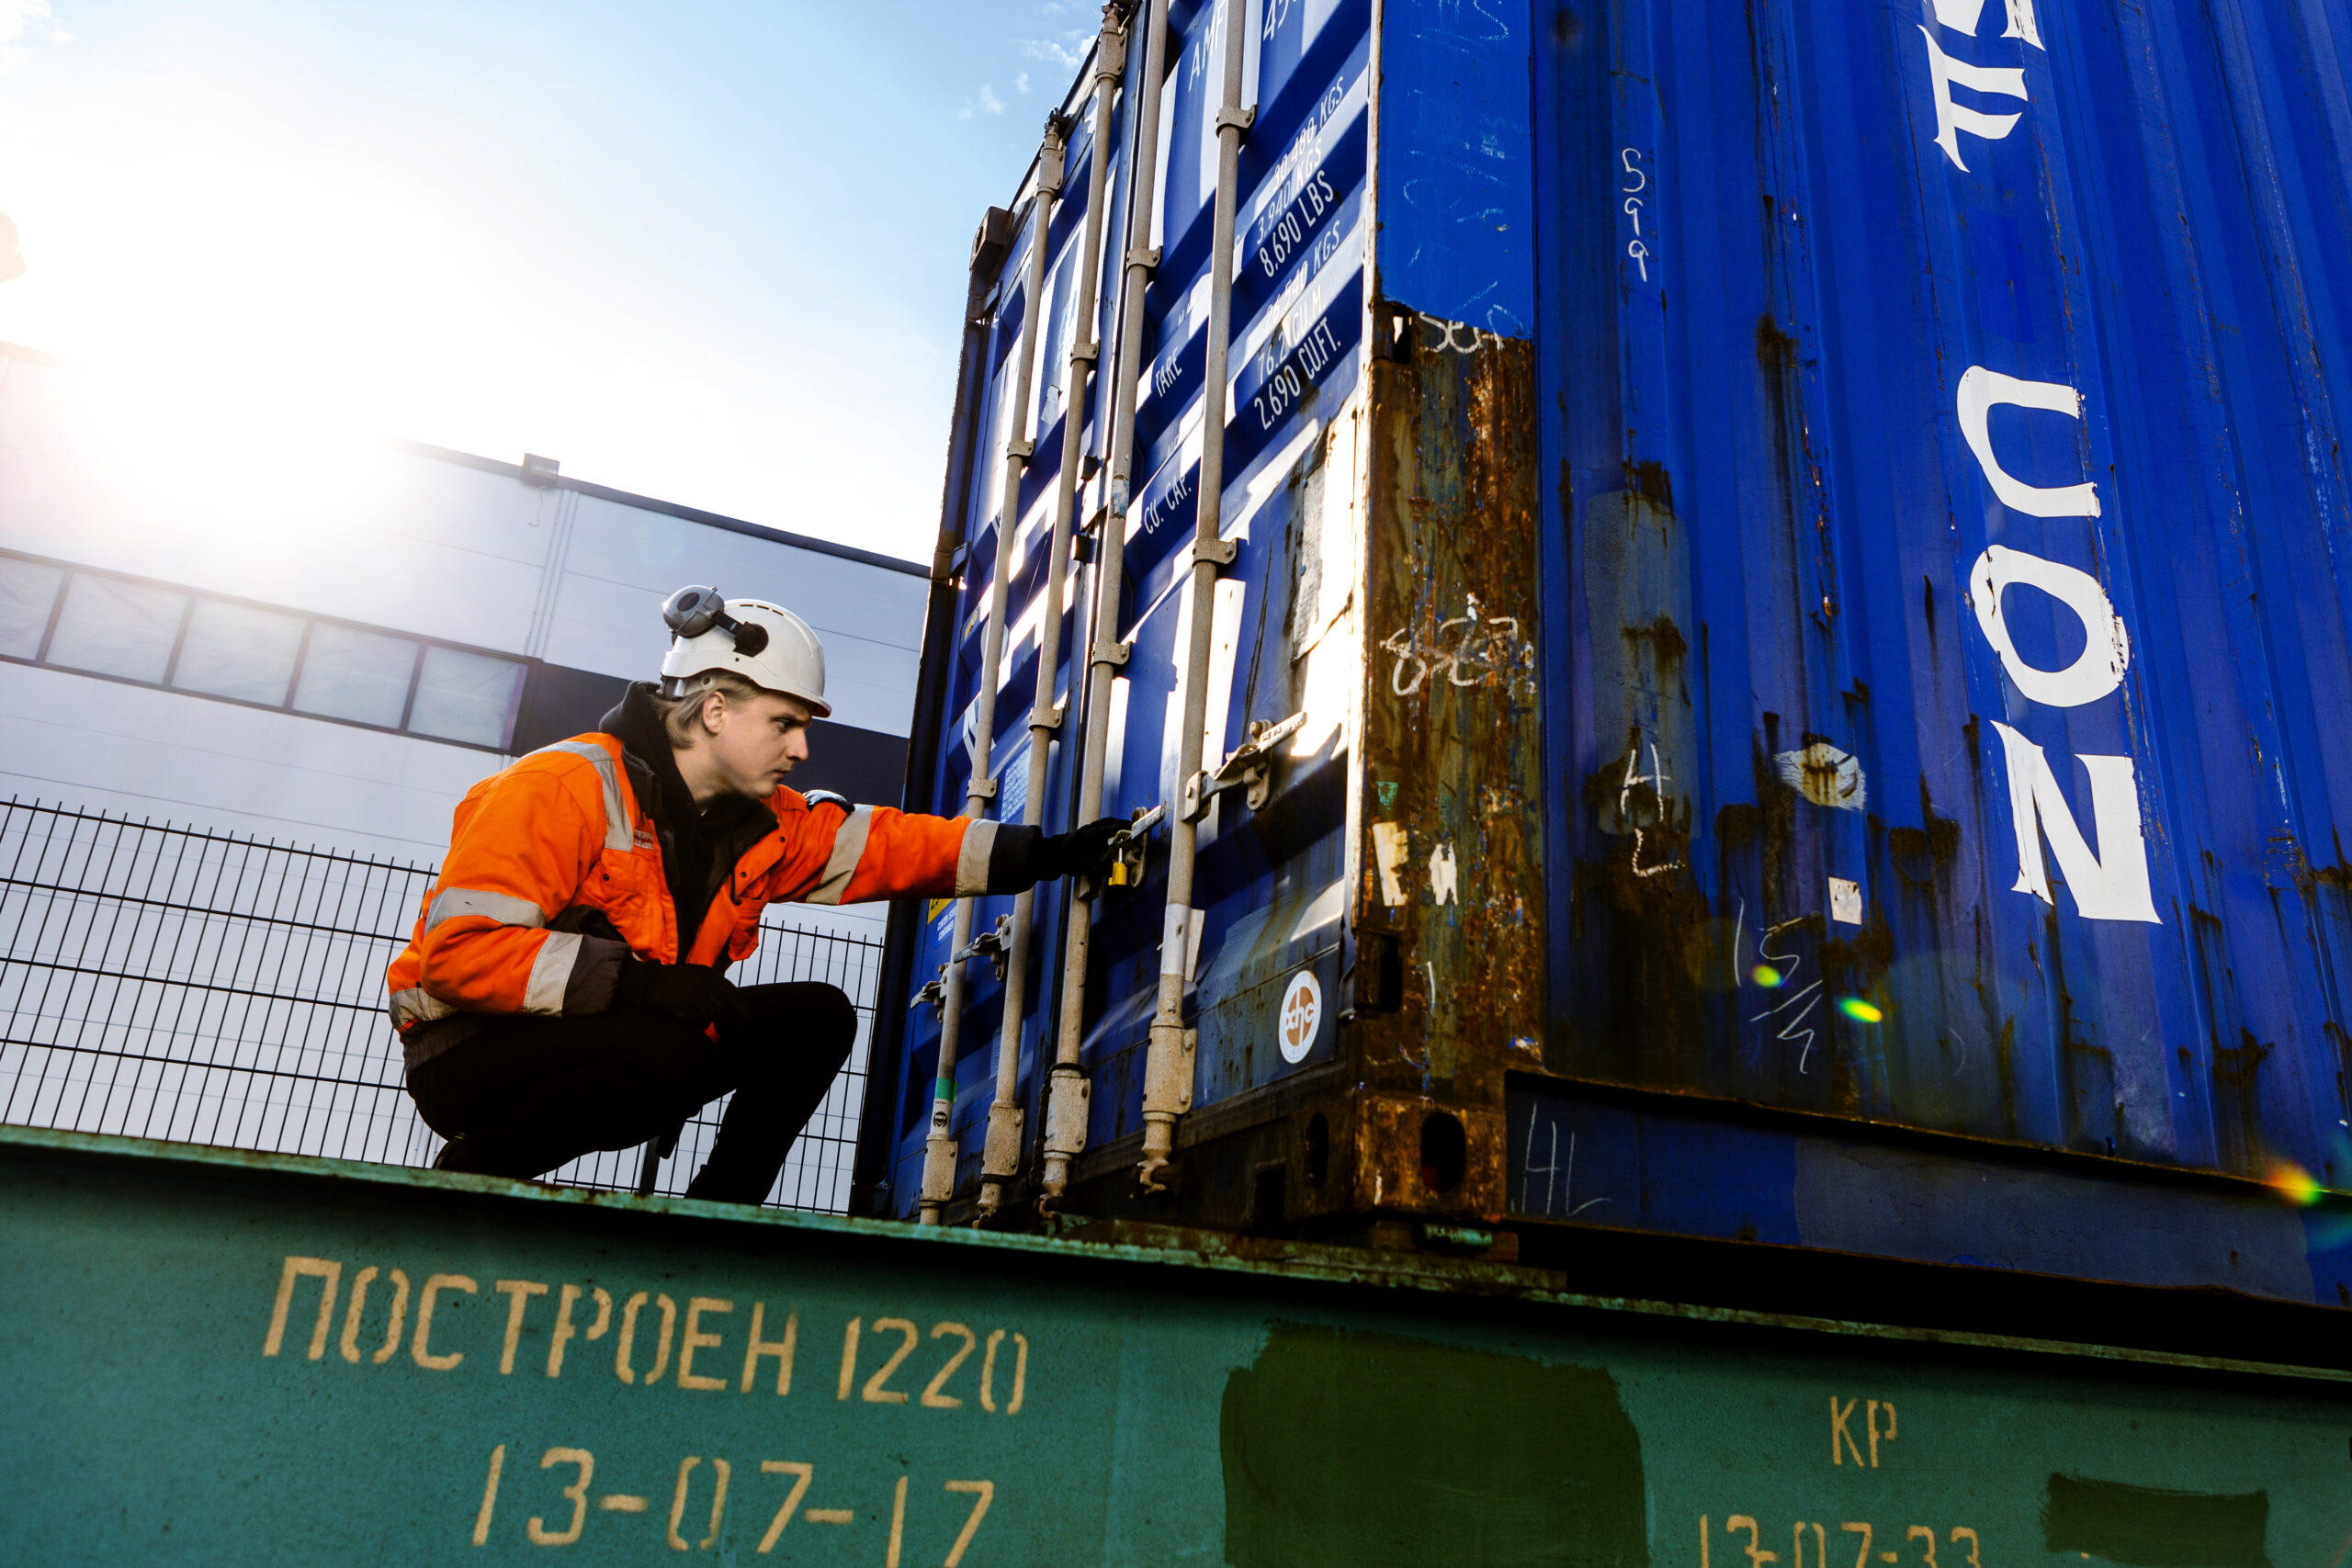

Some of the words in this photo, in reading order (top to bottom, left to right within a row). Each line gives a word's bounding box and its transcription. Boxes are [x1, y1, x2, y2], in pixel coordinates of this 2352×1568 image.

[1319, 75, 1343, 129] KGS
[1295, 137, 1322, 194] KGS
[1298, 170, 1333, 228] LBS
[1314, 220, 1340, 275] KGS
[1155, 346, 1183, 398] TARE
[263, 1256, 797, 1396] ПОСТРОЕН
[837, 1315, 1028, 1416] 1220
